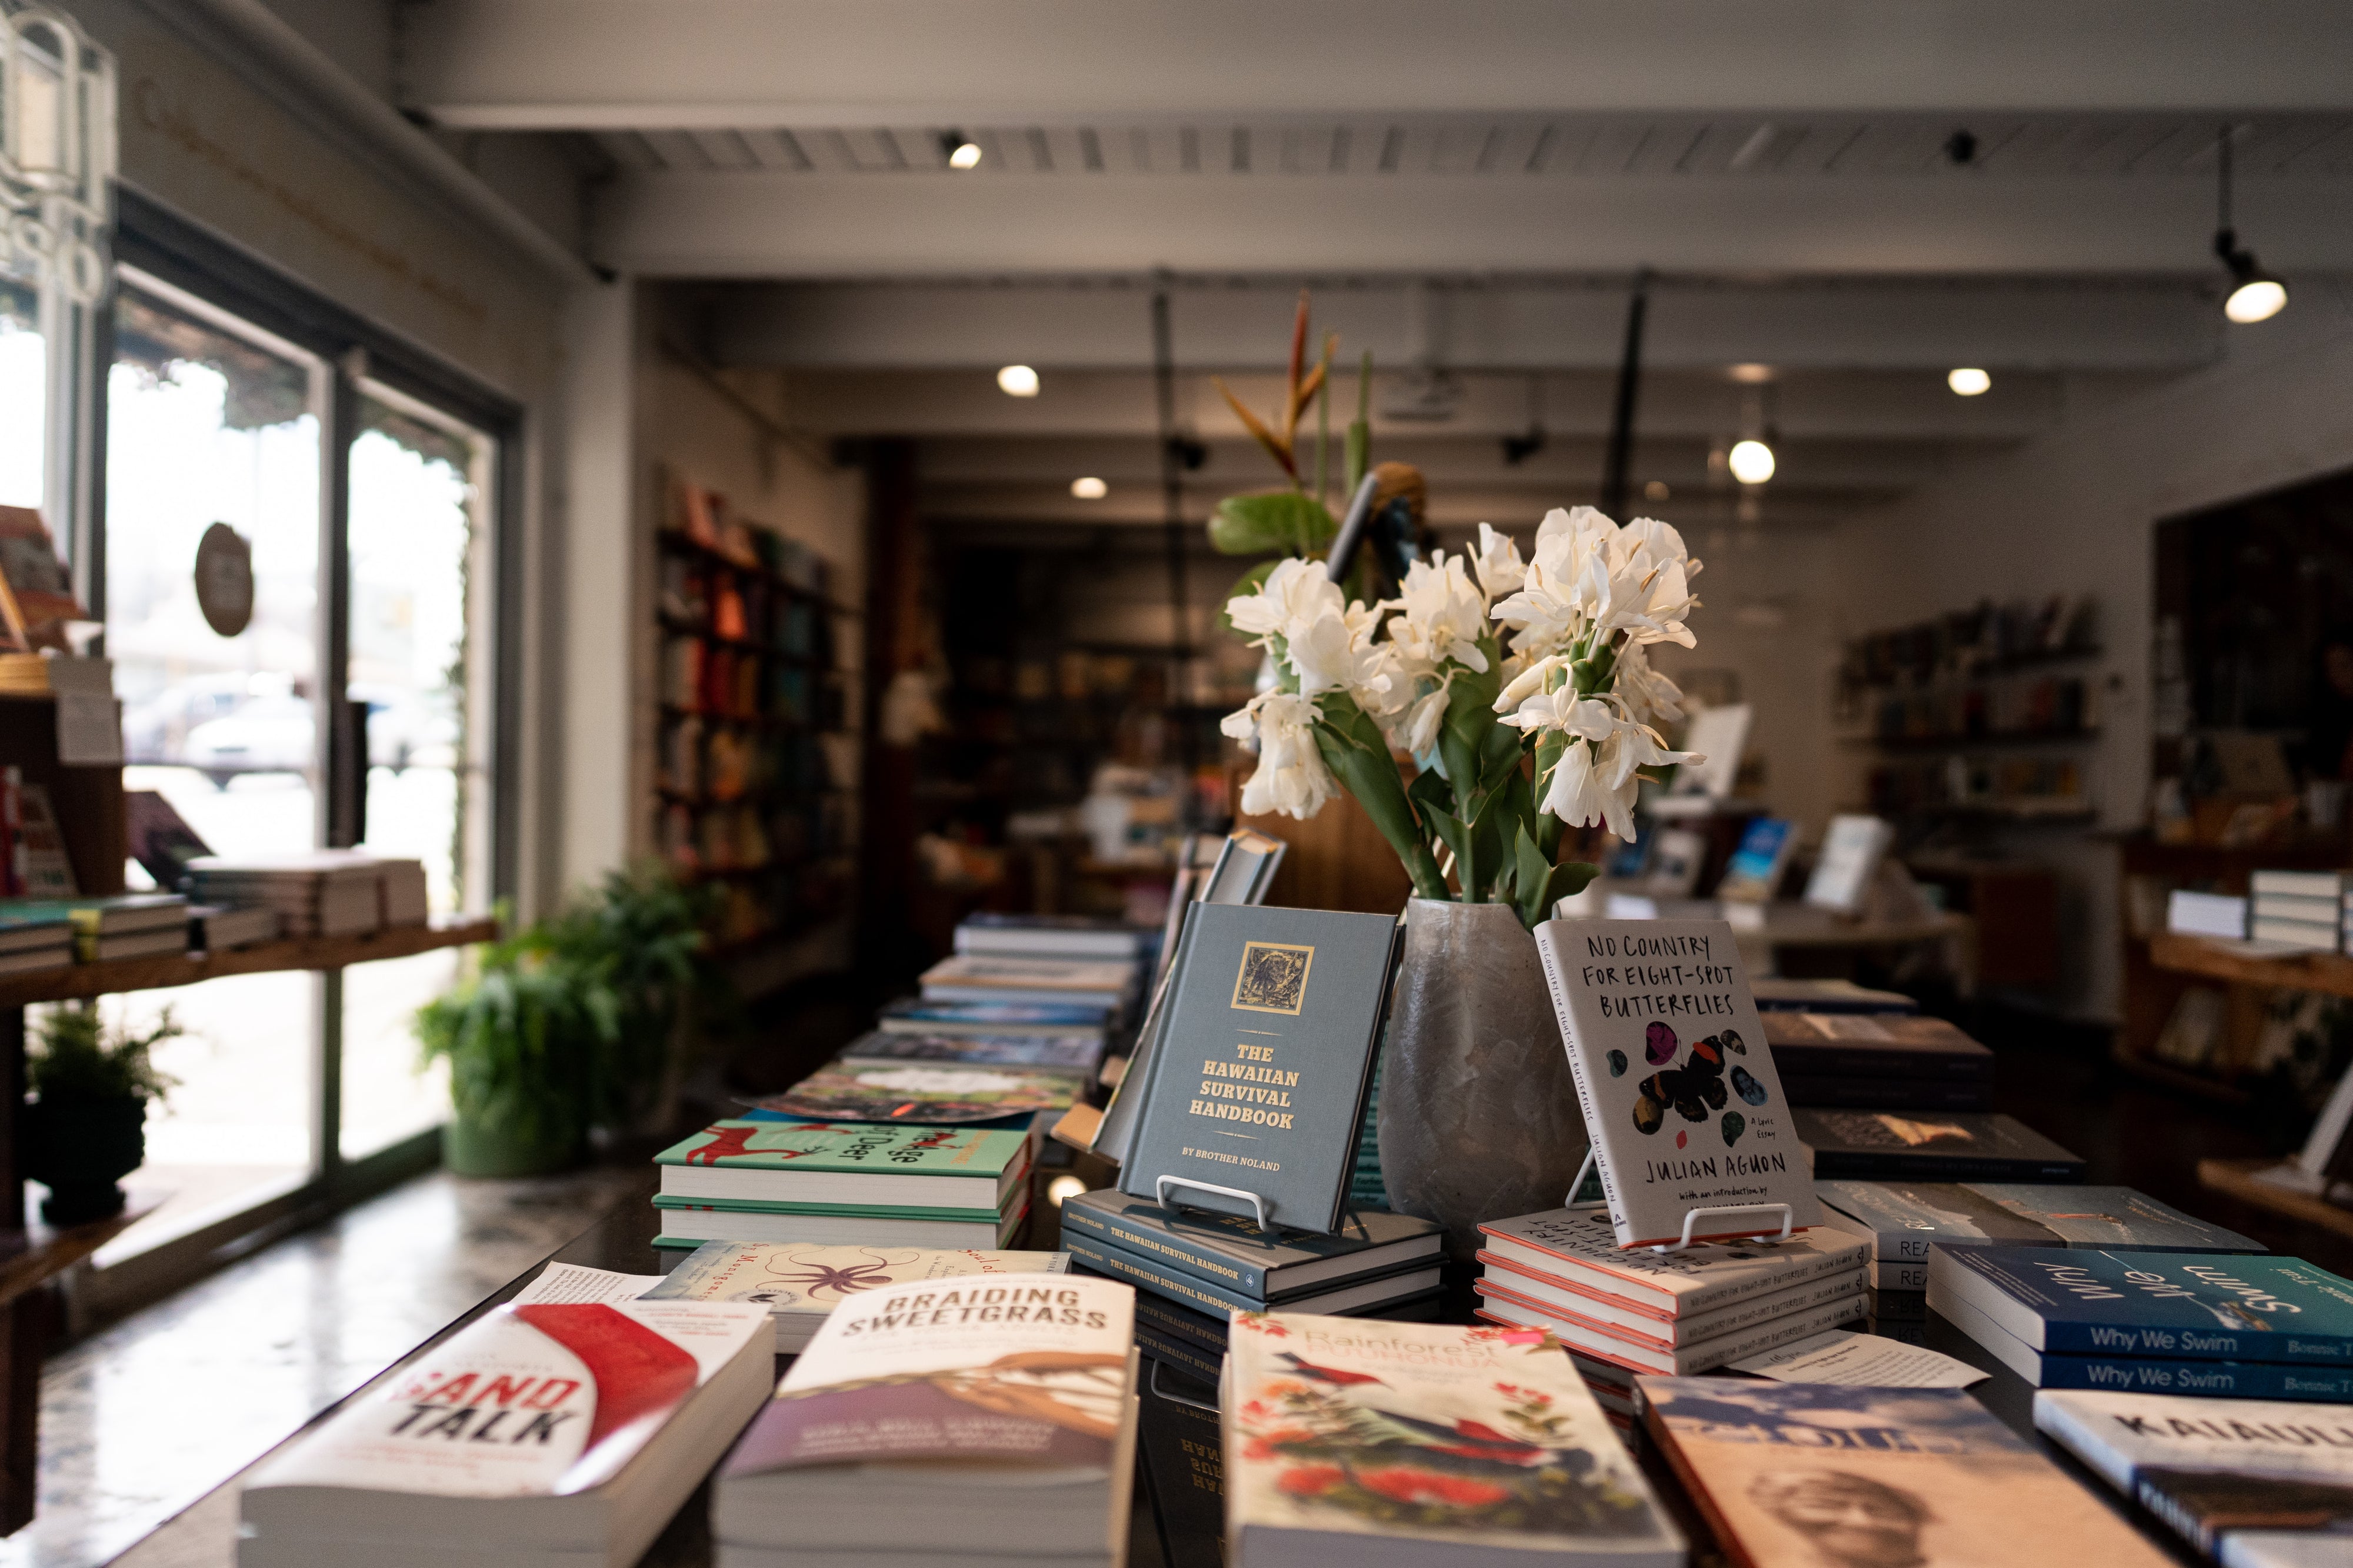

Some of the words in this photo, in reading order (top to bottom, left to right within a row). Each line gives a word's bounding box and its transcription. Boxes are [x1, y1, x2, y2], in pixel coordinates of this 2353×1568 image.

[1541, 939, 1548, 951] NO
[1587, 935, 1616, 957] NO
[1624, 935, 1709, 961] COUNTRY
[1544, 953, 1559, 991] COUNTRY
[1583, 966, 1620, 986] FOR
[1625, 965, 1733, 986] EIGHT-SPOT
[1600, 994, 1734, 1018] BUTTERFLIES
[1559, 1010, 1577, 1059] EIGHT-SPOT
[1237, 1044, 1274, 1062] THE
[1202, 1060, 1300, 1087] HAWAIIAN
[1199, 1080, 1291, 1107] SURVIVAL
[1573, 1063, 1594, 1121] BUTTERFLIES
[1189, 1099, 1294, 1129] HANDBOOK
[1758, 1117, 1774, 1126] Lyric
[1757, 1129, 1775, 1140] Essay
[838, 1136, 894, 1161] Deer
[887, 1144, 940, 1163] Age
[1182, 1147, 1195, 1156] BY
[1195, 1149, 1238, 1165] BROTHER
[1239, 1157, 1280, 1172] NOLAND
[1592, 1133, 1607, 1167] JULIAN
[1646, 1157, 1717, 1184] JULIAN
[1726, 1152, 1786, 1177] AGUON
[1602, 1171, 1617, 1203] AGUON
[1679, 1190, 1698, 1200] with
[1714, 1185, 1758, 1197] introduction
[1759, 1186, 1767, 1196] by
[742, 1242, 769, 1252] Sy
[1067, 1212, 1088, 1226] BROTHER
[1087, 1218, 1104, 1230] NOLAND
[1111, 1226, 1125, 1239] THE
[1125, 1230, 1160, 1252] HAWAIIAN
[1161, 1243, 1196, 1265] SURVIVAL
[1197, 1257, 1239, 1280] HANDBOOK
[957, 1249, 1001, 1263] Soul
[982, 1265, 1006, 1273] of
[1066, 1243, 1087, 1256] BROTHER
[1109, 1258, 1124, 1270] THE
[1124, 1263, 1159, 1285] HAWAIIAN
[1160, 1277, 1196, 1299] SURVIVAL
[1196, 1291, 1239, 1312] HANDBOOK
[1774, 1267, 1808, 1285] BUTTERFLIES
[2033, 1262, 2125, 1300] Why
[2124, 1271, 2197, 1297] We
[2182, 1266, 2302, 1314] Swim
[882, 1287, 1081, 1315] BRAIDING
[1772, 1296, 1807, 1314] BUTTERFLIES
[841, 1303, 1109, 1337] SWEETGRASS
[1304, 1330, 1498, 1358] Rainforest
[2090, 1326, 2138, 1351] Why
[2141, 1330, 2176, 1349] We
[2181, 1330, 2237, 1352] Swim
[2087, 1365, 2135, 1389] Why
[2138, 1366, 2172, 1386] We
[2178, 1368, 2235, 1389] Swim
[388, 1403, 581, 1446] TALK
